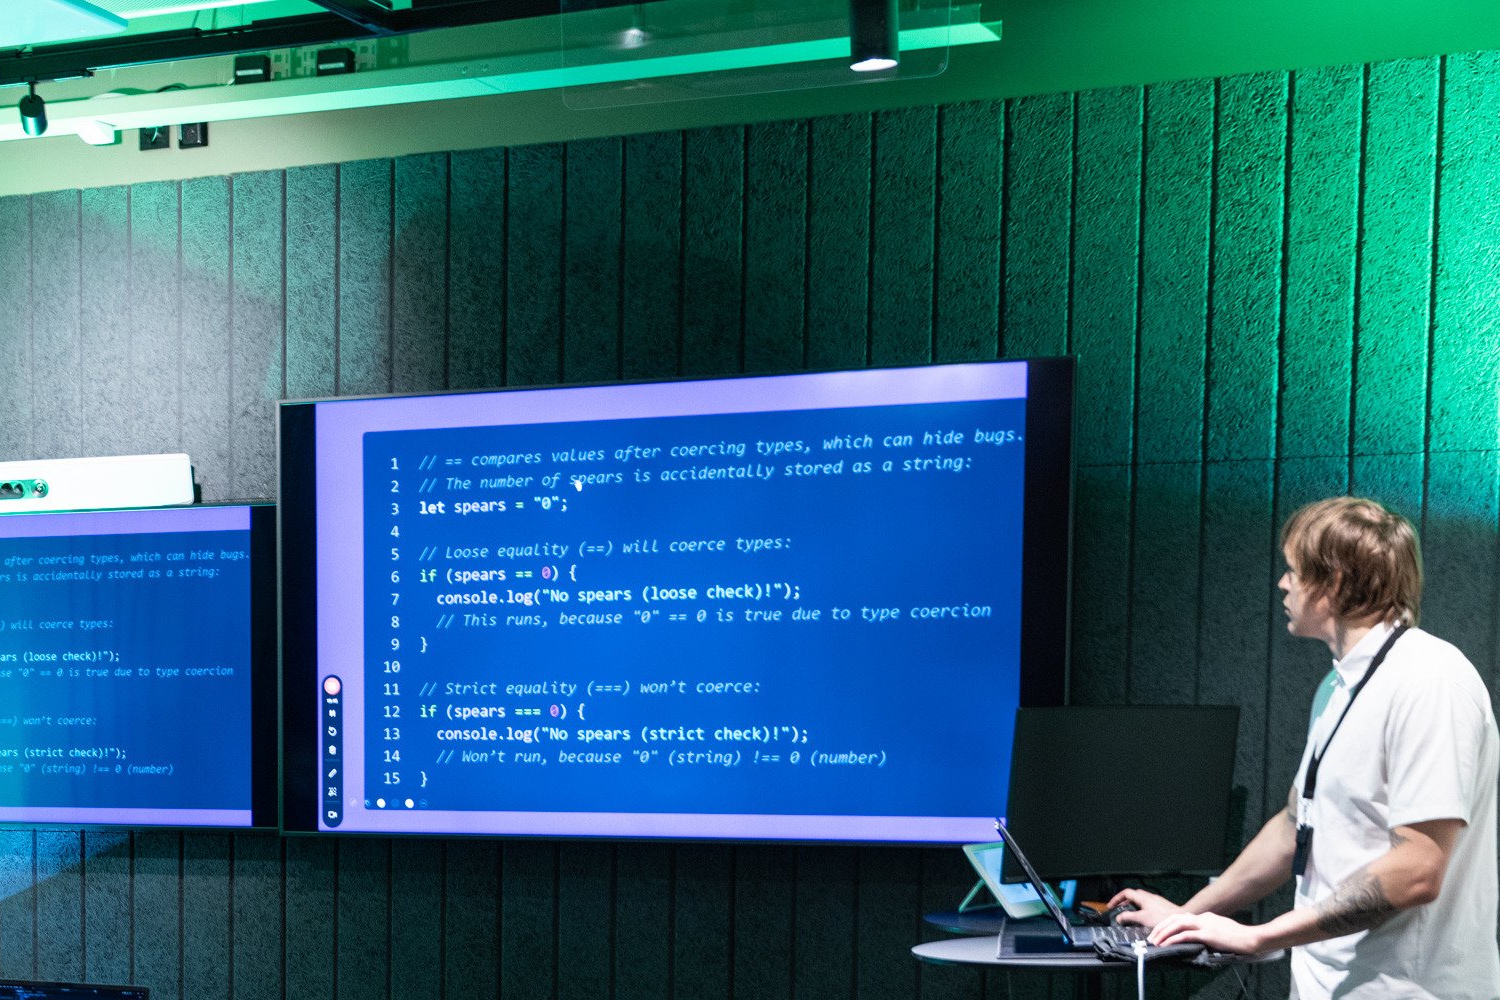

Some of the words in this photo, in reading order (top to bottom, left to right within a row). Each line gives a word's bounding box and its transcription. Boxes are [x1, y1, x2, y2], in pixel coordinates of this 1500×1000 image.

[391, 457, 399, 470] 1
[418, 454, 437, 470] //
[444, 457, 463, 466] ==
[471, 452, 541, 467] compares
[551, 448, 605, 462] values
[614, 445, 661, 462] after
[670, 441, 746, 457] coercing
[756, 440, 810, 456] types,
[823, 434, 873, 450] which
[883, 435, 913, 447] can
[923, 430, 964, 445] hide
[974, 428, 1022, 445] bugs.
[390, 480, 399, 493] 2
[418, 478, 437, 493] //
[446, 477, 471, 490] The
[480, 474, 533, 489] number
[541, 472, 561, 489] of
[569, 472, 623, 487] spears
[633, 468, 651, 482] is
[660, 463, 775, 481] accidentally
[784, 460, 844, 476] stored
[852, 461, 872, 473] as
[882, 460, 893, 472] a
[902, 455, 972, 472] string:
[391, 503, 400, 516] 3
[419, 500, 446, 515] let
[454, 501, 506, 516] spears
[514, 500, 525, 510] =
[534, 496, 567, 512] "0";
[390, 525, 400, 538] 4
[391, 548, 400, 561] 5
[418, 546, 437, 561] //
[445, 546, 489, 559] Loose
[497, 542, 569, 560] equality
[578, 540, 613, 558] (==)
[622, 539, 659, 553] will
[669, 540, 726, 552] coerce
[736, 537, 791, 553] types:
[391, 570, 400, 583] 6
[420, 569, 437, 583] if
[446, 568, 506, 584] (spears
[514, 570, 534, 579] ==
[541, 565, 559, 582] 0)
[569, 564, 577, 582] {
[391, 593, 400, 606] 7
[437, 588, 570, 606] console.log("No
[578, 589, 632, 604] spears
[642, 586, 698, 603] (loose
[706, 582, 800, 601] check)!");
[391, 615, 400, 628] 8
[436, 614, 454, 629] //
[463, 613, 497, 626] This
[506, 615, 547, 628] runs,
[559, 612, 623, 625] because
[634, 609, 660, 624] "0"
[668, 613, 688, 622] ==
[696, 609, 707, 623] 0
[716, 608, 734, 622] is
[744, 608, 782, 622] true
[792, 606, 821, 621] due
[831, 607, 851, 620] to
[861, 606, 900, 622] type
[910, 603, 991, 619] coercion
[390, 638, 400, 651] 9
[420, 636, 428, 654] }
[24, 652, 57, 663] (loose
[383, 660, 401, 673] 10
[384, 683, 400, 696] 11
[419, 682, 437, 697] //
[445, 681, 497, 695] Strict
[505, 680, 577, 697] equality
[587, 680, 630, 696] (===)
[696, 682, 760, 693] coerce:
[384, 705, 400, 718] 12
[420, 704, 437, 718] if
[446, 704, 506, 720] (spears
[514, 707, 542, 716] ===
[550, 703, 567, 720] 0)
[577, 703, 585, 720] {
[383, 728, 401, 740] 13
[437, 726, 569, 744] console.log("No
[577, 729, 631, 743] spears
[641, 726, 705, 743] (strict
[714, 725, 808, 744] check)!");
[25, 747, 63, 759] (strict
[383, 749, 400, 762] 14
[436, 749, 454, 765] //
[514, 752, 547, 766] run,
[558, 750, 622, 763] because
[633, 750, 658, 764] "0"
[668, 750, 741, 767] (string)
[753, 750, 780, 764] !==
[790, 750, 801, 764] 0
[810, 750, 886, 767] (number)
[384, 772, 400, 785] 15
[420, 771, 428, 788] }
